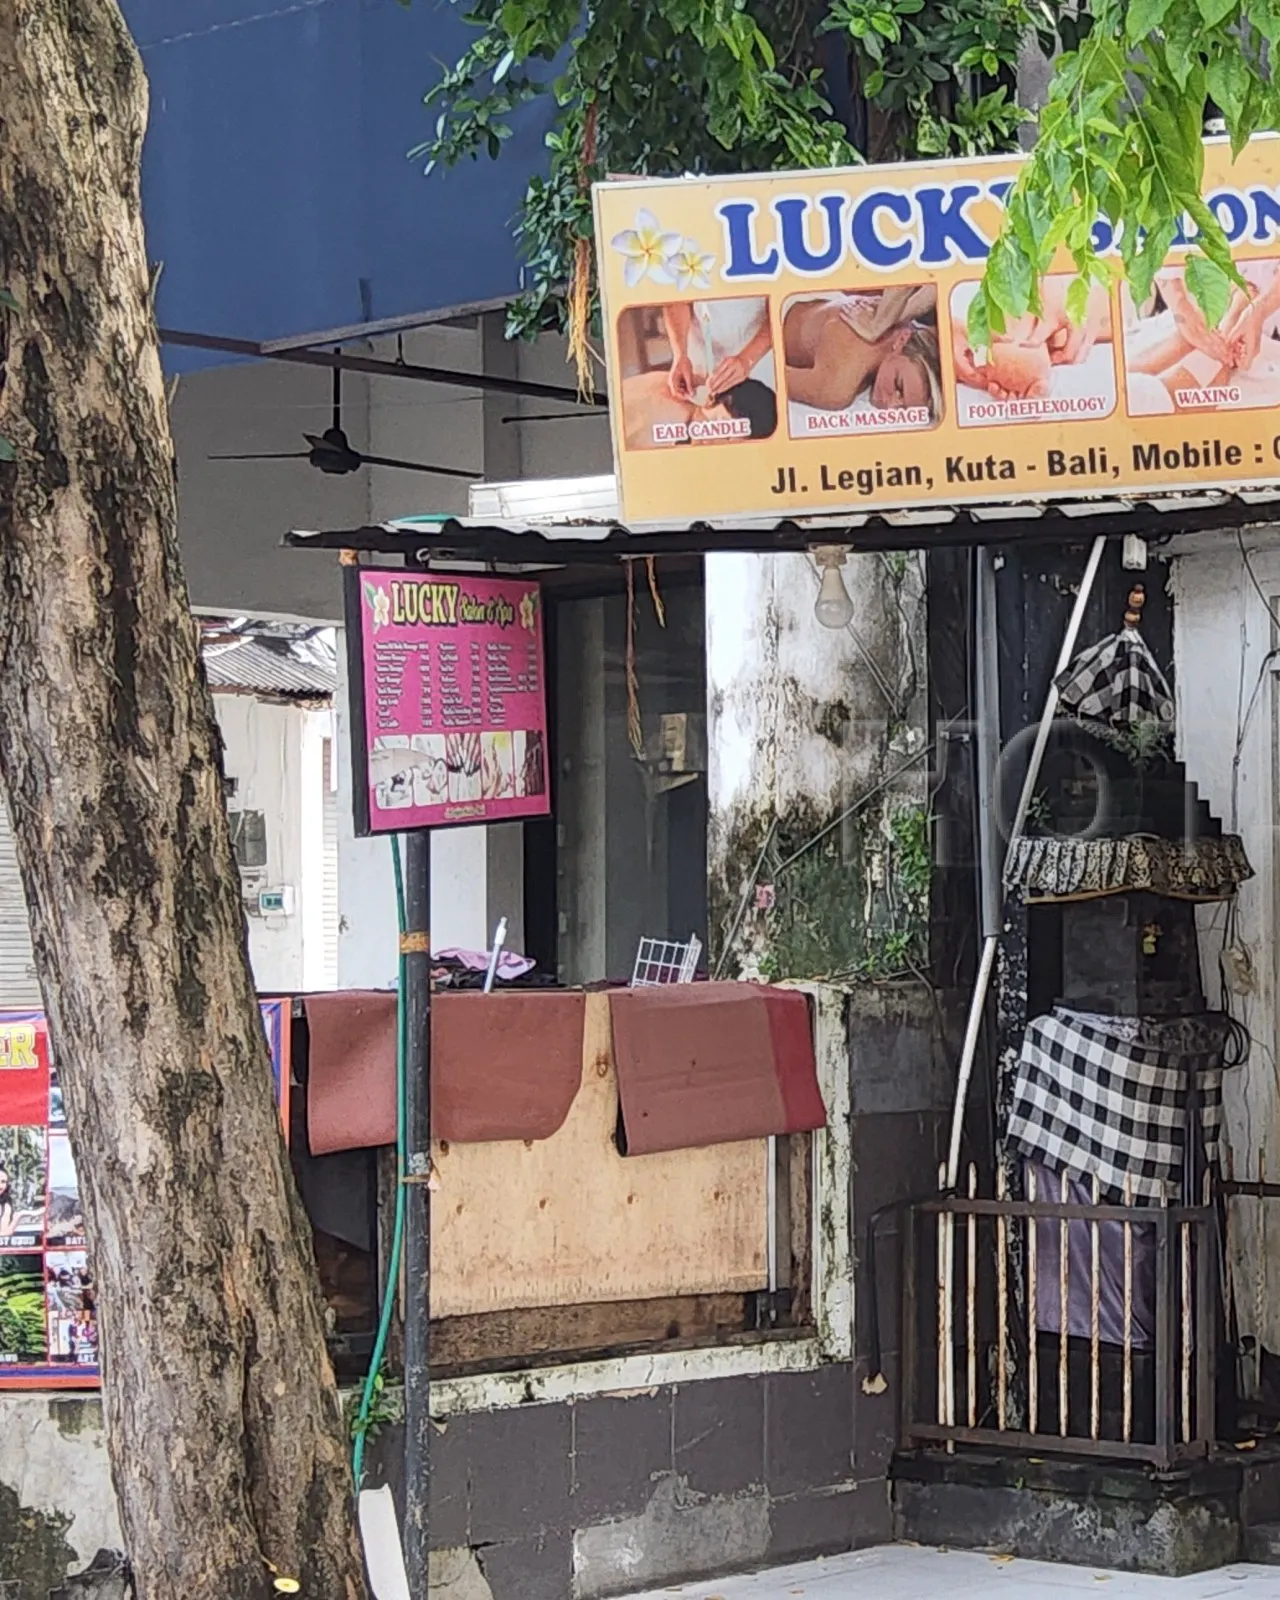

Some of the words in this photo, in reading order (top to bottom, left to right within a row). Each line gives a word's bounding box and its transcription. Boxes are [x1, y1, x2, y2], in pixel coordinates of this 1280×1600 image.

[968, 403, 1004, 419] FOOT
[1010, 396, 1107, 416] REFLEXOLOGY
[1178, 388, 1240, 405] WAXING
[808, 411, 849, 430] BACK
[855, 408, 928, 426] MASSAGE
[654, 425, 685, 441] EAR
[690, 420, 750, 438] CANDLE
[820, 459, 933, 496] Legian,
[946, 455, 1015, 483] Kuta
[1047, 447, 1119, 477] Bali,
[1133, 439, 1242, 471] Mobile
[390, 581, 459, 624] LUCKY
